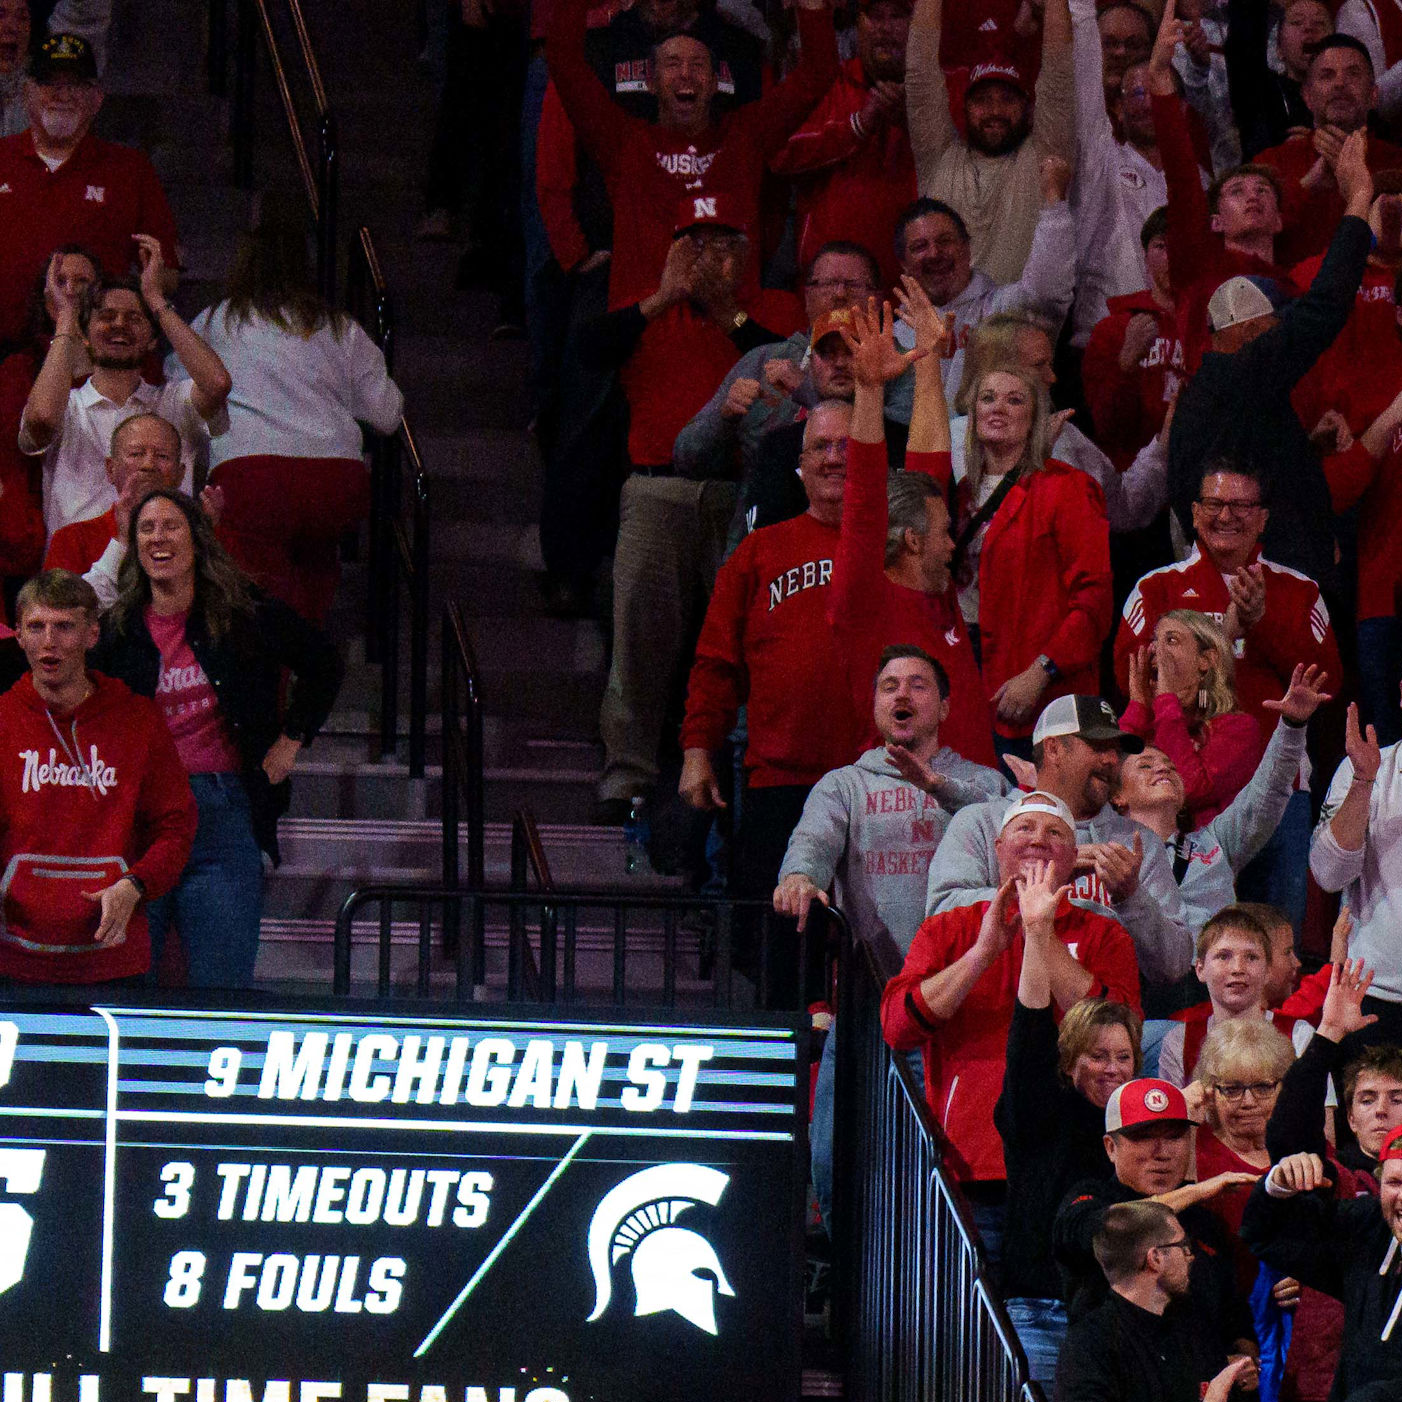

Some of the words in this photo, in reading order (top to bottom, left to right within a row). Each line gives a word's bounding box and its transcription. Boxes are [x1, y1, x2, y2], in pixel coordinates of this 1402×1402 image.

[693, 197, 718, 219] N
[767, 558, 834, 613] NEBR
[18, 743, 119, 797] Nebraska
[864, 787, 942, 816] NEBRA
[863, 848, 936, 878] BASKET
[205, 1046, 242, 1099] 9
[257, 1031, 604, 1112] MICHIGAN
[620, 1044, 715, 1115] ST
[1151, 1093, 1163, 1106] N
[153, 1162, 195, 1221] 3
[216, 1163, 496, 1230] TIMEOUTS
[164, 1251, 206, 1309] 8
[222, 1252, 408, 1317] FOULS
